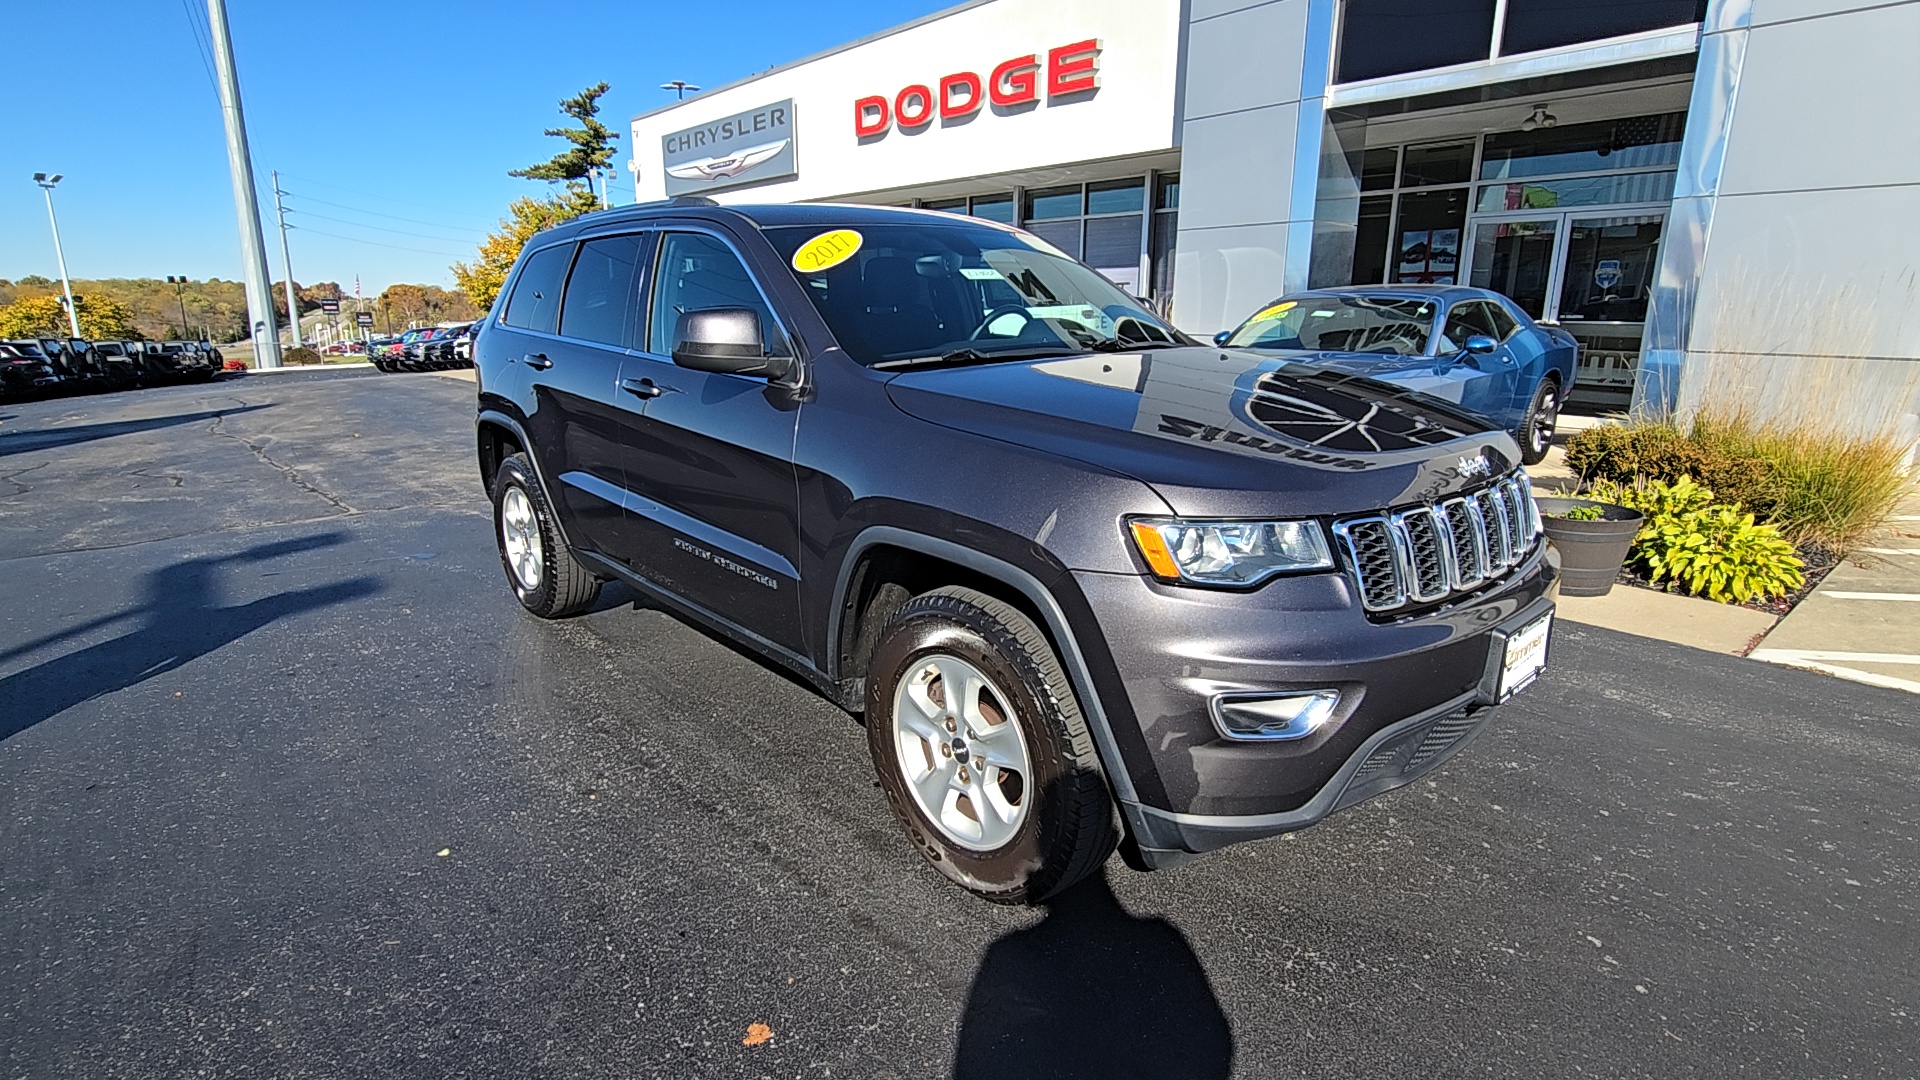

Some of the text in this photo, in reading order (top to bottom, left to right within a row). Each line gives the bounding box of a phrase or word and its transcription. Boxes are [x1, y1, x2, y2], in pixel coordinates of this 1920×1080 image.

[854, 38, 1101, 138] DODGE
[666, 107, 786, 154] CHRYSLER
[805, 233, 850, 267] 2017
